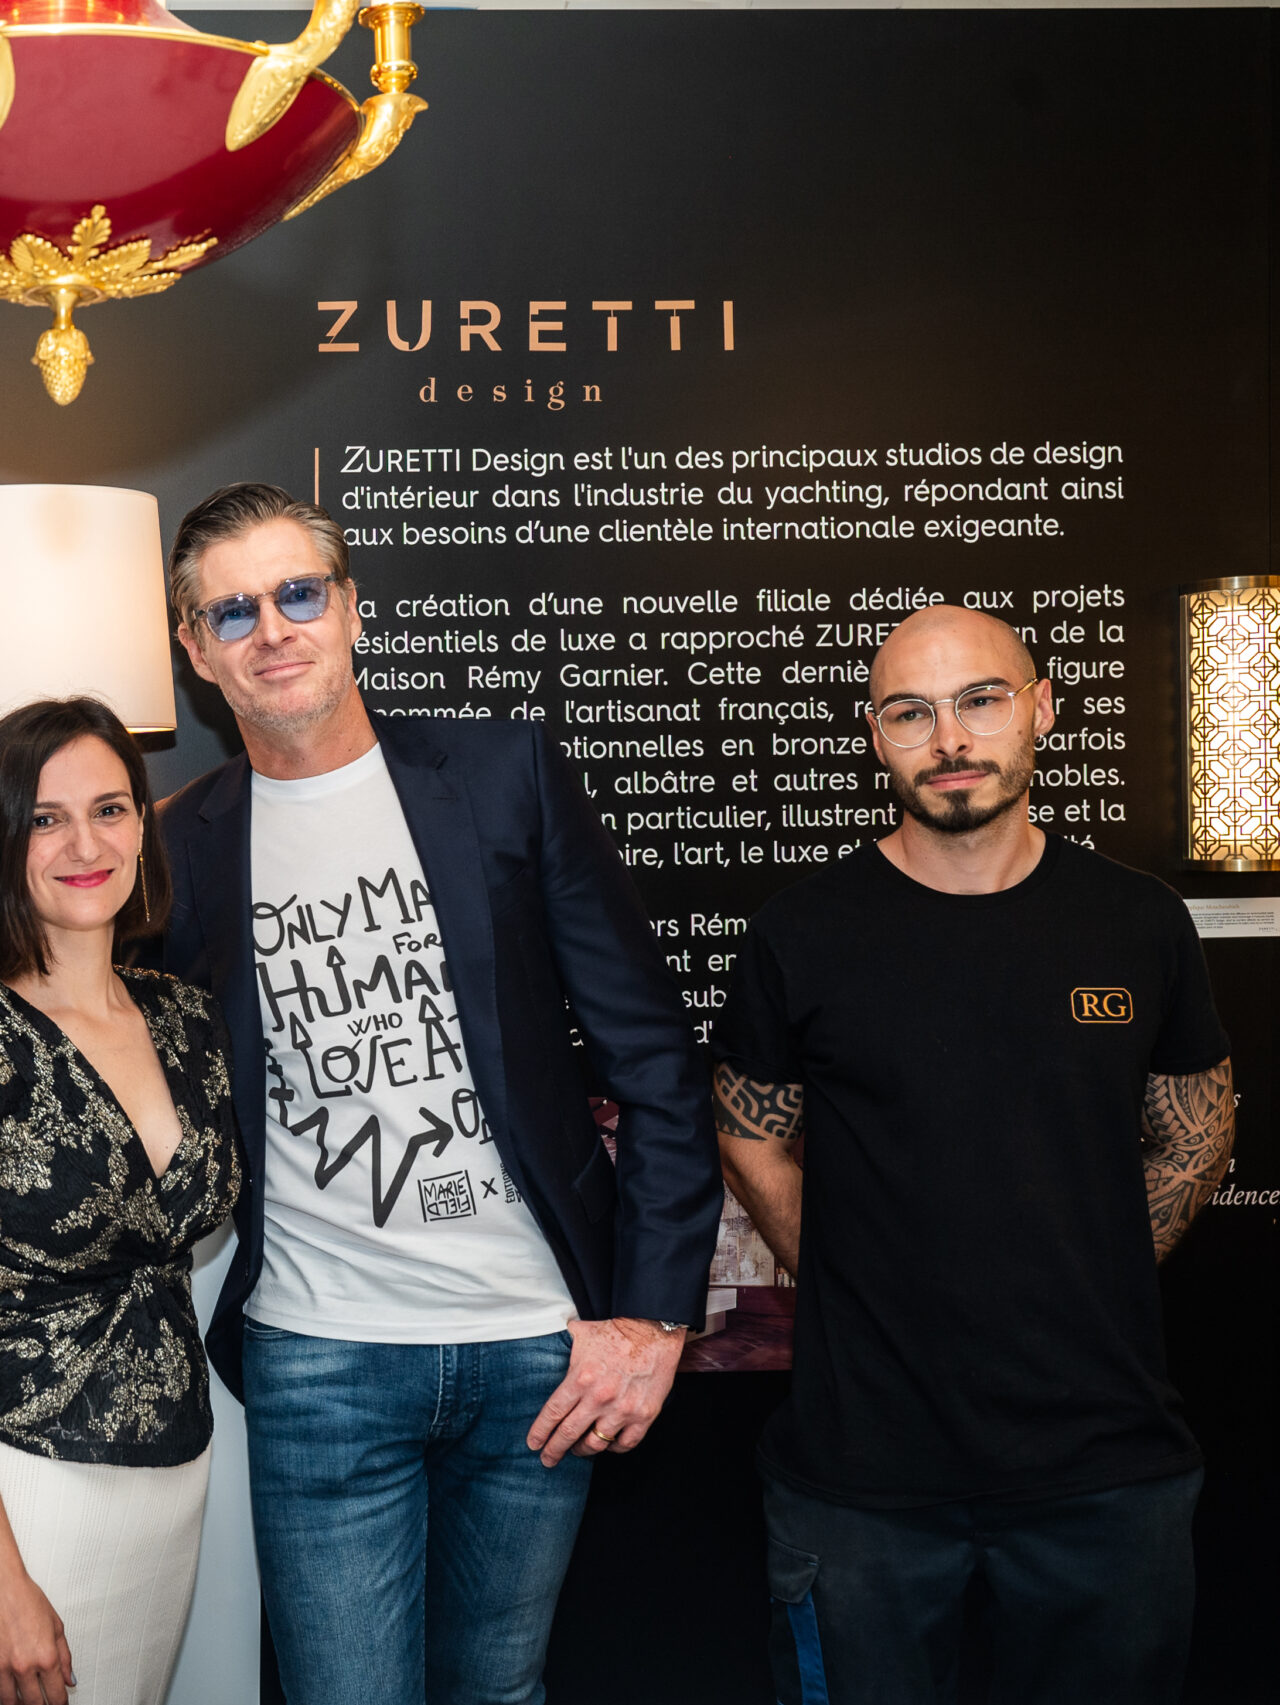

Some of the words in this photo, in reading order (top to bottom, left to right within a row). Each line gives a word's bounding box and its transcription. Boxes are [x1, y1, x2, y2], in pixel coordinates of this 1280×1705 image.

[318, 300, 734, 352] ZURETTI
[419, 377, 602, 410] design
[339, 445, 461, 474] ZURETTI
[472, 447, 566, 478] Design
[573, 446, 613, 471] est
[621, 446, 668, 470] l'un
[674, 445, 724, 470] des
[732, 444, 878, 474] principaux
[885, 442, 983, 467] studios
[989, 441, 1025, 465] de
[1033, 440, 1124, 470] design
[341, 485, 480, 510] d'intérieur
[491, 483, 561, 508] dans
[574, 482, 704, 507] l'industrie
[717, 481, 753, 505] du
[764, 479, 890, 510] yachting,
[904, 476, 1049, 507] répondant
[1061, 476, 1124, 500] ainsi
[344, 527, 394, 547] aux
[402, 520, 507, 546] besoins
[598, 518, 714, 543] clientèle
[722, 515, 915, 541] internationale
[923, 513, 1065, 544] exigeante.
[358, 600, 378, 619] a
[395, 593, 511, 618] création
[623, 589, 738, 615] nouvelle
[756, 588, 831, 613] filiale
[849, 586, 945, 611] dédiée
[963, 592, 1014, 609] aux
[1033, 583, 1125, 614] projets
[354, 630, 499, 655] ésidentiels
[511, 628, 547, 653] de
[560, 628, 616, 652] luxe
[628, 632, 648, 651] a
[660, 624, 805, 655] rapproché
[1050, 620, 1086, 644] de
[1099, 619, 1125, 643] la
[355, 667, 446, 691] Maison
[468, 665, 542, 694] Rémy
[559, 663, 669, 688] Garnier.
[687, 661, 762, 686] Cette
[782, 660, 869, 684] derniè
[1046, 656, 1125, 686] figure
[511, 701, 545, 721] de
[565, 698, 701, 724] l'artisanat
[718, 696, 834, 726] français,
[1083, 696, 1126, 715] ses
[721, 738, 755, 757] en
[772, 732, 867, 755] bronze
[614, 770, 716, 795] albâtre
[731, 768, 758, 793] et
[773, 767, 859, 792] autres
[1030, 763, 1125, 787] nobles.
[627, 805, 772, 836] particulier,
[782, 802, 897, 828] illustrent
[1064, 799, 1091, 822] et
[1100, 798, 1126, 822] la
[674, 841, 731, 868] l'art,
[740, 840, 764, 864] le
[773, 840, 829, 863] luxe
[252, 893, 352, 956] ONLY
[358, 867, 432, 932] MA
[691, 913, 750, 936] Rém
[393, 932, 443, 955] FOR
[1080, 992, 1127, 1017] RG
[347, 1012, 403, 1037] WHO
[423, 1176, 467, 1205] MARIE
[1206, 1184, 1280, 1205] idence
